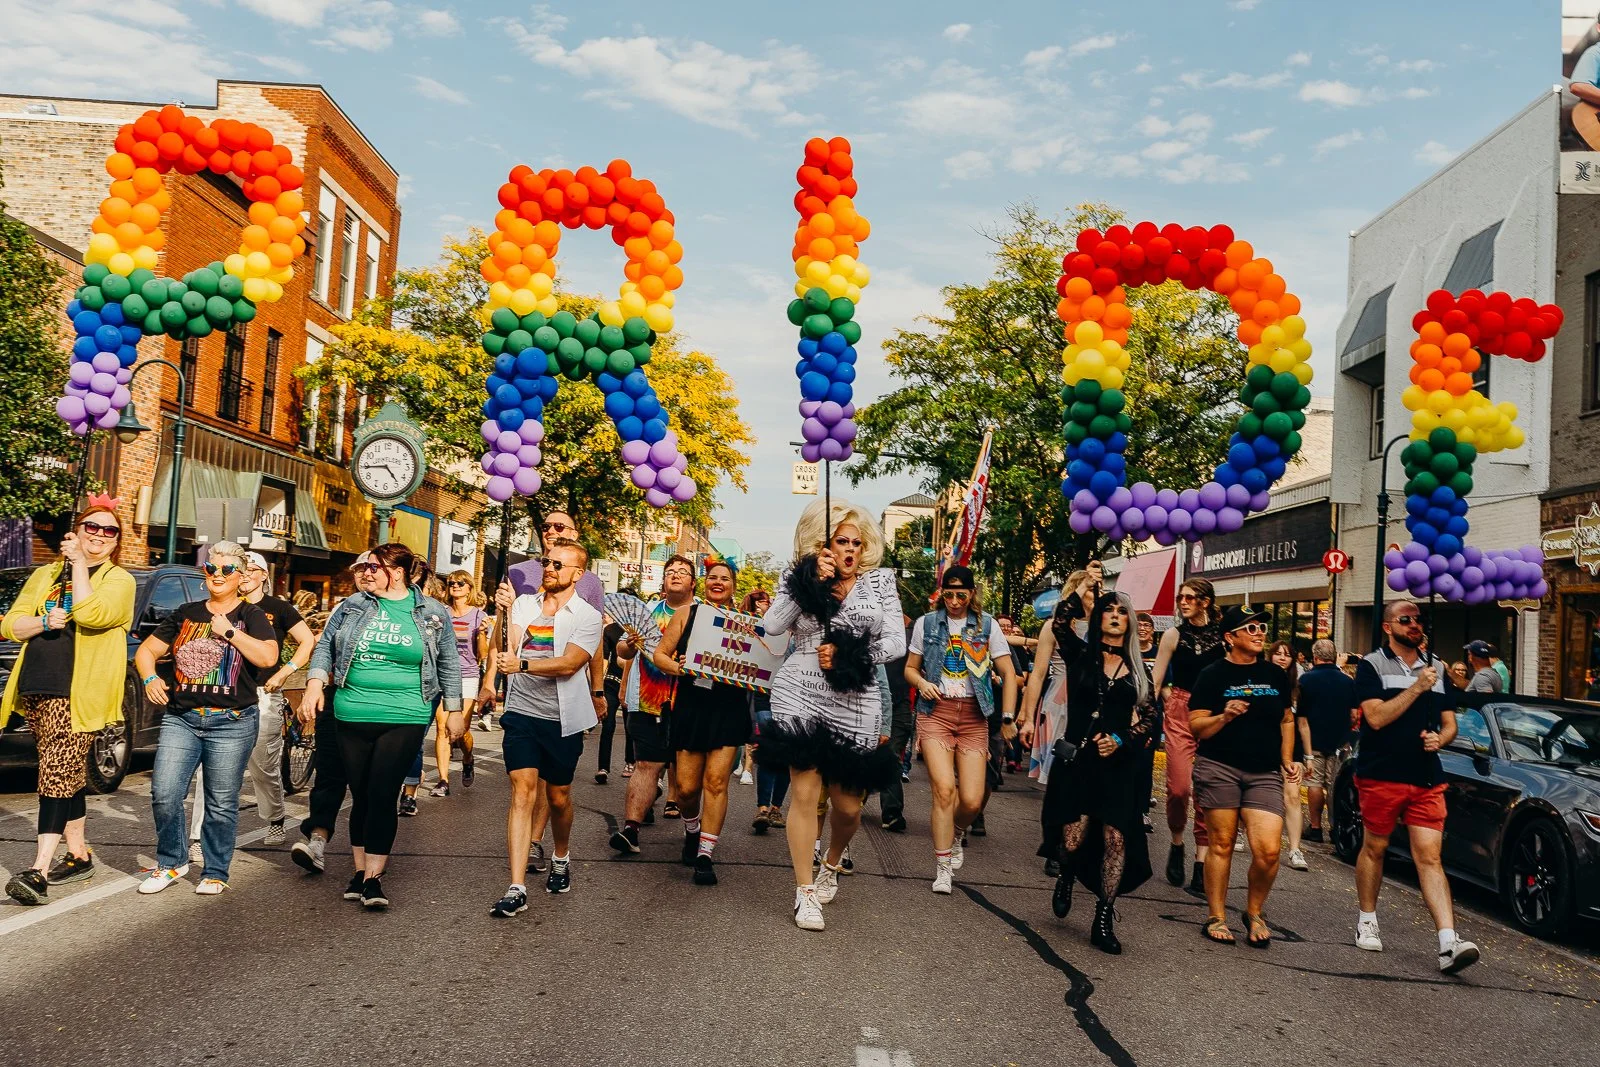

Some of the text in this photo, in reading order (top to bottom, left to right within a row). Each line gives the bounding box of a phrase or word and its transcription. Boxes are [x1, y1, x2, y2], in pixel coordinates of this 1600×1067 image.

[794, 465, 817, 474] CROSS
[796, 474, 815, 482] WALK
[1246, 539, 1298, 566] JEWELERS
[366, 620, 402, 633] OVE
[362, 629, 414, 647] EEDS
[725, 633, 747, 656] IS
[699, 650, 759, 683] POWER
[180, 683, 231, 695] PRIDE
